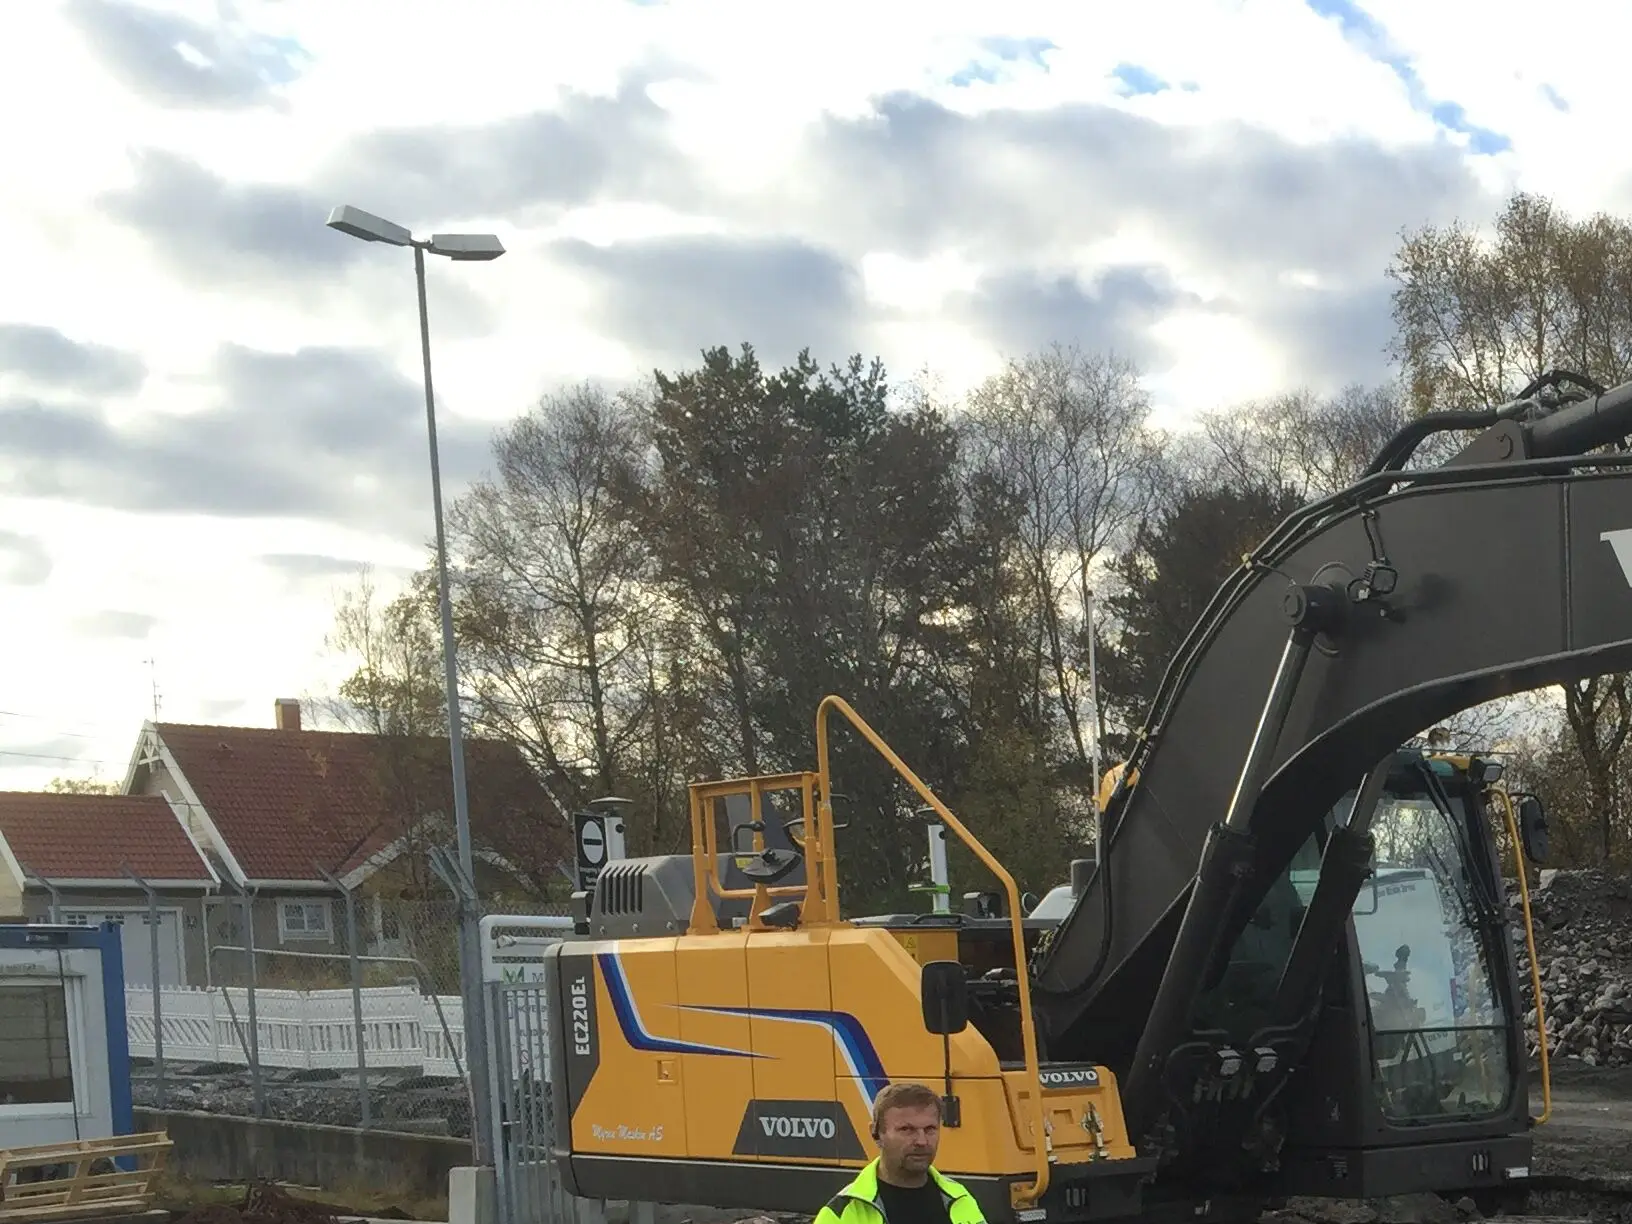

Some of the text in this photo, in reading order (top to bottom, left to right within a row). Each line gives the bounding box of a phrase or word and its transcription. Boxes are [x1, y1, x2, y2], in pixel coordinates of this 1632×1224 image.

[571, 975, 591, 1056] EC220EL
[1038, 1070, 1098, 1084] VOLVO
[758, 1116, 836, 1139] VOLVO
